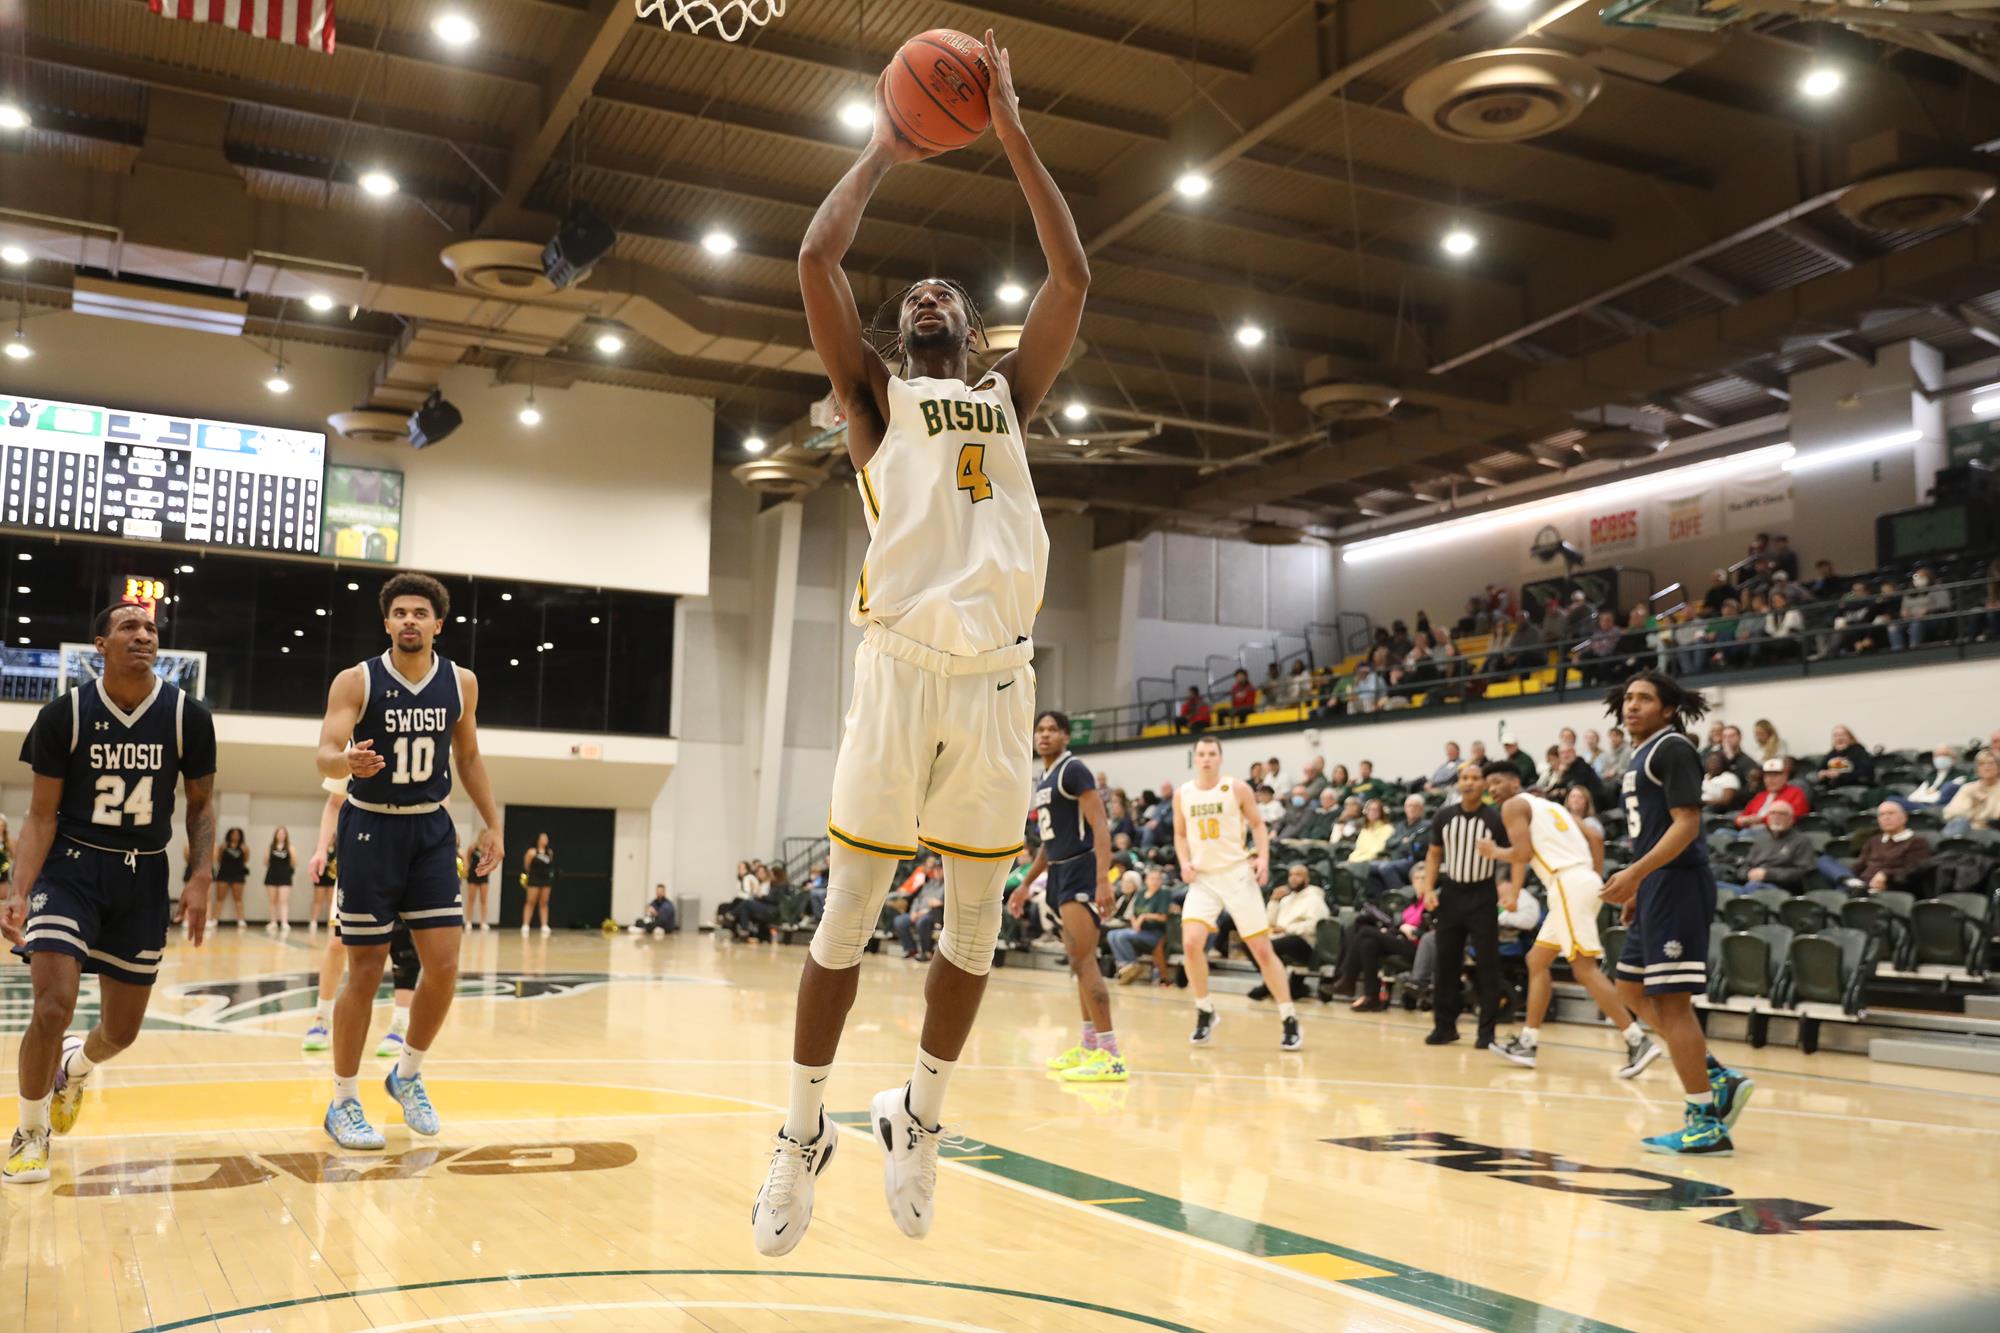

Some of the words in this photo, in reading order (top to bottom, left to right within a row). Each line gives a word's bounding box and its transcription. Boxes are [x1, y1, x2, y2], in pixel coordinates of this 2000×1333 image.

[920, 399, 1011, 436] BISON
[956, 443, 993, 504] 4
[385, 708, 447, 732] SWOSU
[90, 743, 163, 770] SWOSU
[392, 737, 435, 784] 10
[91, 774, 154, 826] 24
[1190, 802, 1223, 818] BISON
[1198, 818, 1220, 840] 10
